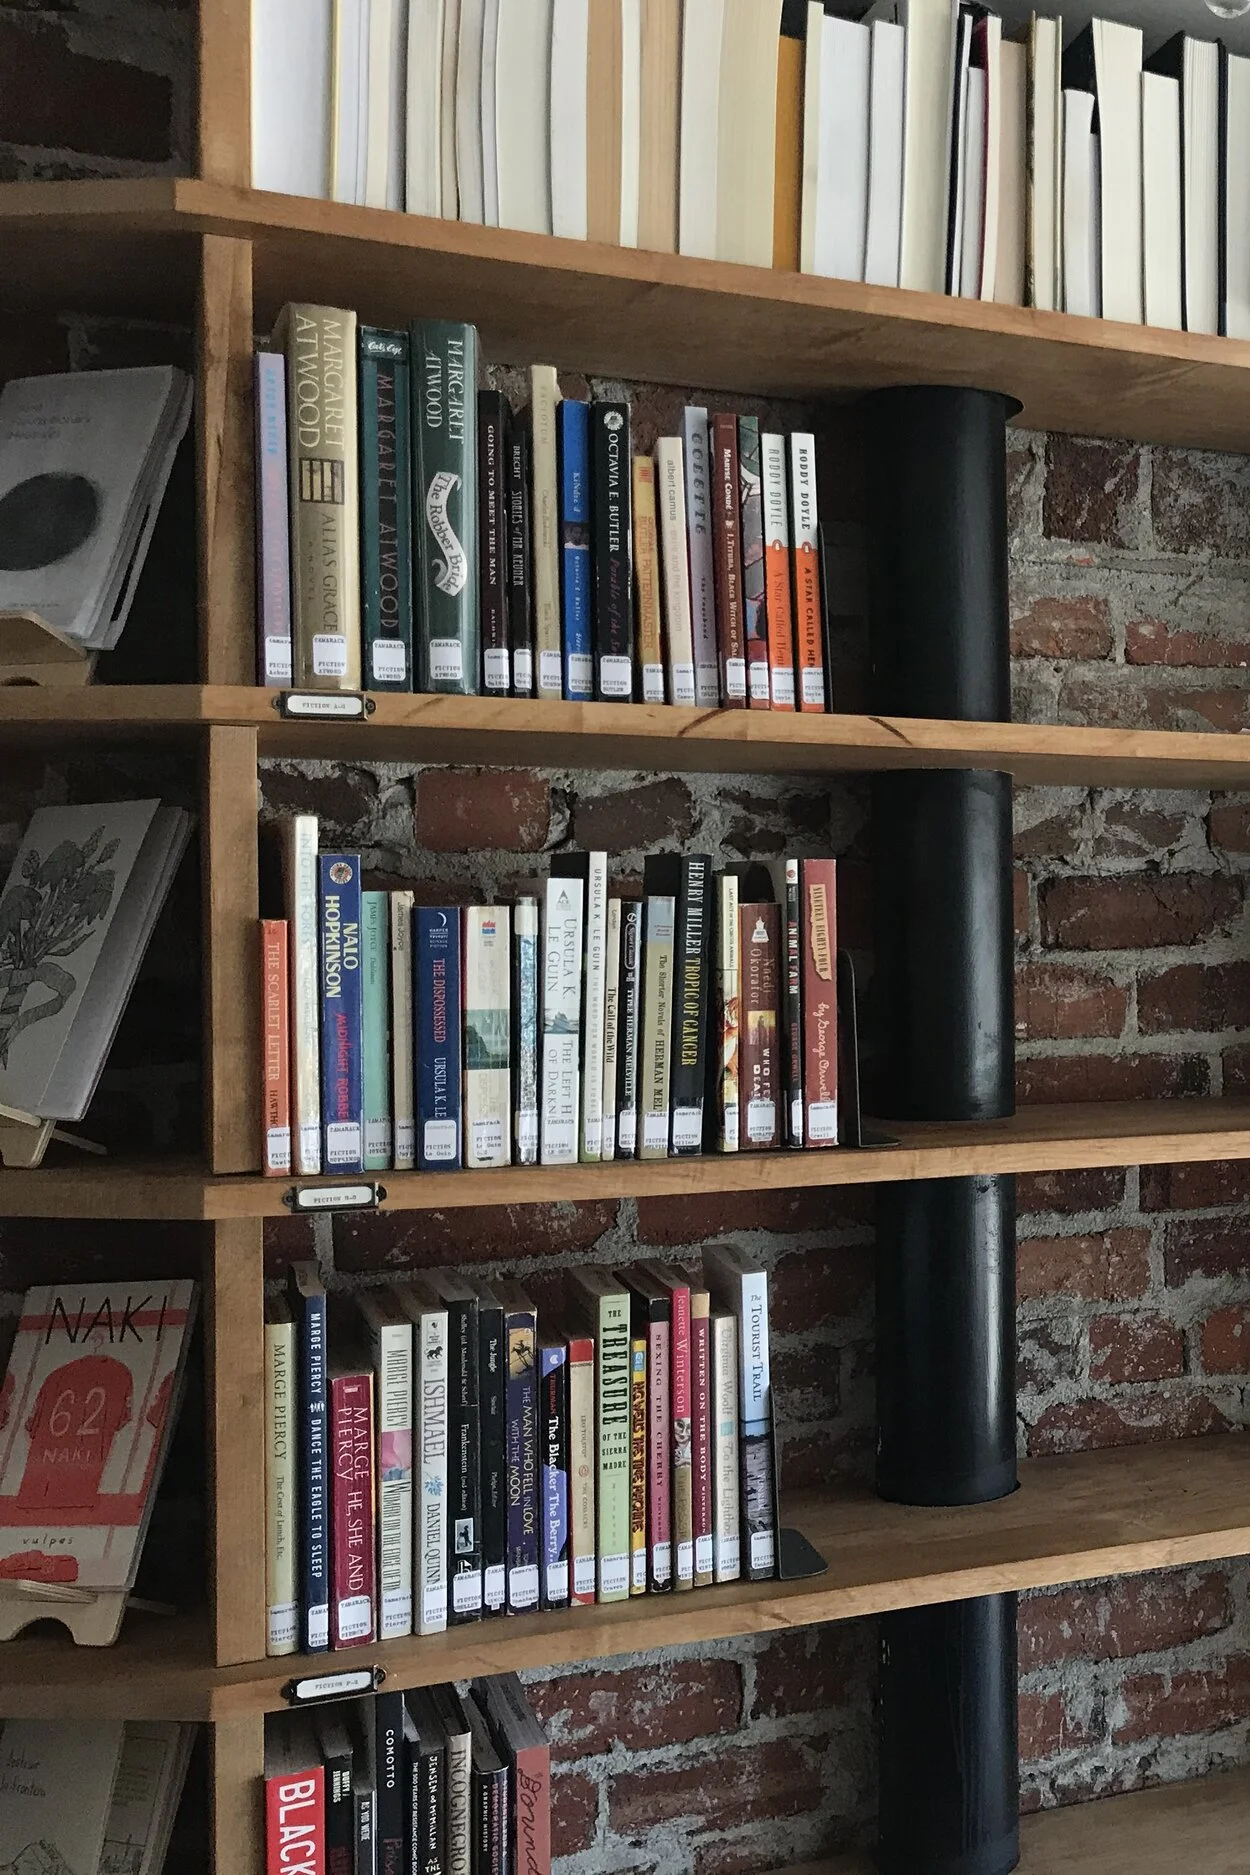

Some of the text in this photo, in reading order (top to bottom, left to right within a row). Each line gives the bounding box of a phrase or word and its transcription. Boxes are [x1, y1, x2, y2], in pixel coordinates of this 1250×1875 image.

[296, 313, 321, 448] ATWOOD
[322, 319, 345, 451] MARGARET
[425, 350, 443, 428] ATWOOD
[447, 340, 465, 445] MARGARET
[378, 374, 399, 629] MARGARET ATWOOD
[487, 425, 497, 586] GOING TO MEET THE MAN
[608, 433, 620, 552] OCTAVIA E. BUTLER
[768, 448, 783, 527] RODDY DOYLE
[799, 448, 811, 530] RODDY DOYLE
[322, 514, 338, 632] ALIAS GRACE
[429, 474, 463, 591] The Robber Bride
[324, 895, 341, 998] HOPKINSON
[343, 922, 359, 970] NALO
[685, 861, 705, 955] HENRY MILLER
[547, 926, 561, 992] LE GUIN
[563, 918, 577, 999] URSULA K.
[657, 971, 667, 999] Shorter
[658, 954, 668, 969] The
[788, 920, 798, 994] ANIMAL FARM
[267, 942, 281, 1081] THE SCARLET LETTER
[606, 987, 616, 1063] The Call of the Wild
[657, 1002, 666, 1026] Novels
[681, 957, 701, 1066] TROPIC OF CANCER
[653, 1039, 665, 1084] HERMAN
[763, 1048, 771, 1076] WHO
[45, 1294, 168, 1345] NAKI
[608, 1309, 622, 1318] THE
[751, 1304, 763, 1402] TOURIST TRAIL
[49, 1386, 106, 1438] 62
[273, 1343, 287, 1460] MARGE PIERCY
[386, 1349, 408, 1428] MARGE PIERCY
[602, 1323, 628, 1425] TREASURE
[42, 1447, 93, 1465] NAKI
[310, 1313, 323, 1578] MARGE PIERCY DANCE THE EAGLE TO SLEEP
[336, 1407, 354, 1481] PIERCY
[353, 1406, 369, 1480] MARGE
[424, 1378, 446, 1465] ISHMAEL
[509, 1418, 520, 1506] WITH THE MOON
[523, 1387, 534, 1536] THE MAN WHO FELL IN LOVE
[601, 1446, 627, 1457] SIERRA
[548, 1415, 560, 1517] The Blacker The
[602, 1460, 627, 1471] MADRE
[22, 1535, 75, 1547] vulpes
[345, 1490, 364, 1591] HE, SHE AND
[314, 1681, 343, 1691] FICTION
[385, 1729, 395, 1789] COMOTTO
[279, 1779, 316, 1875] BLACK
